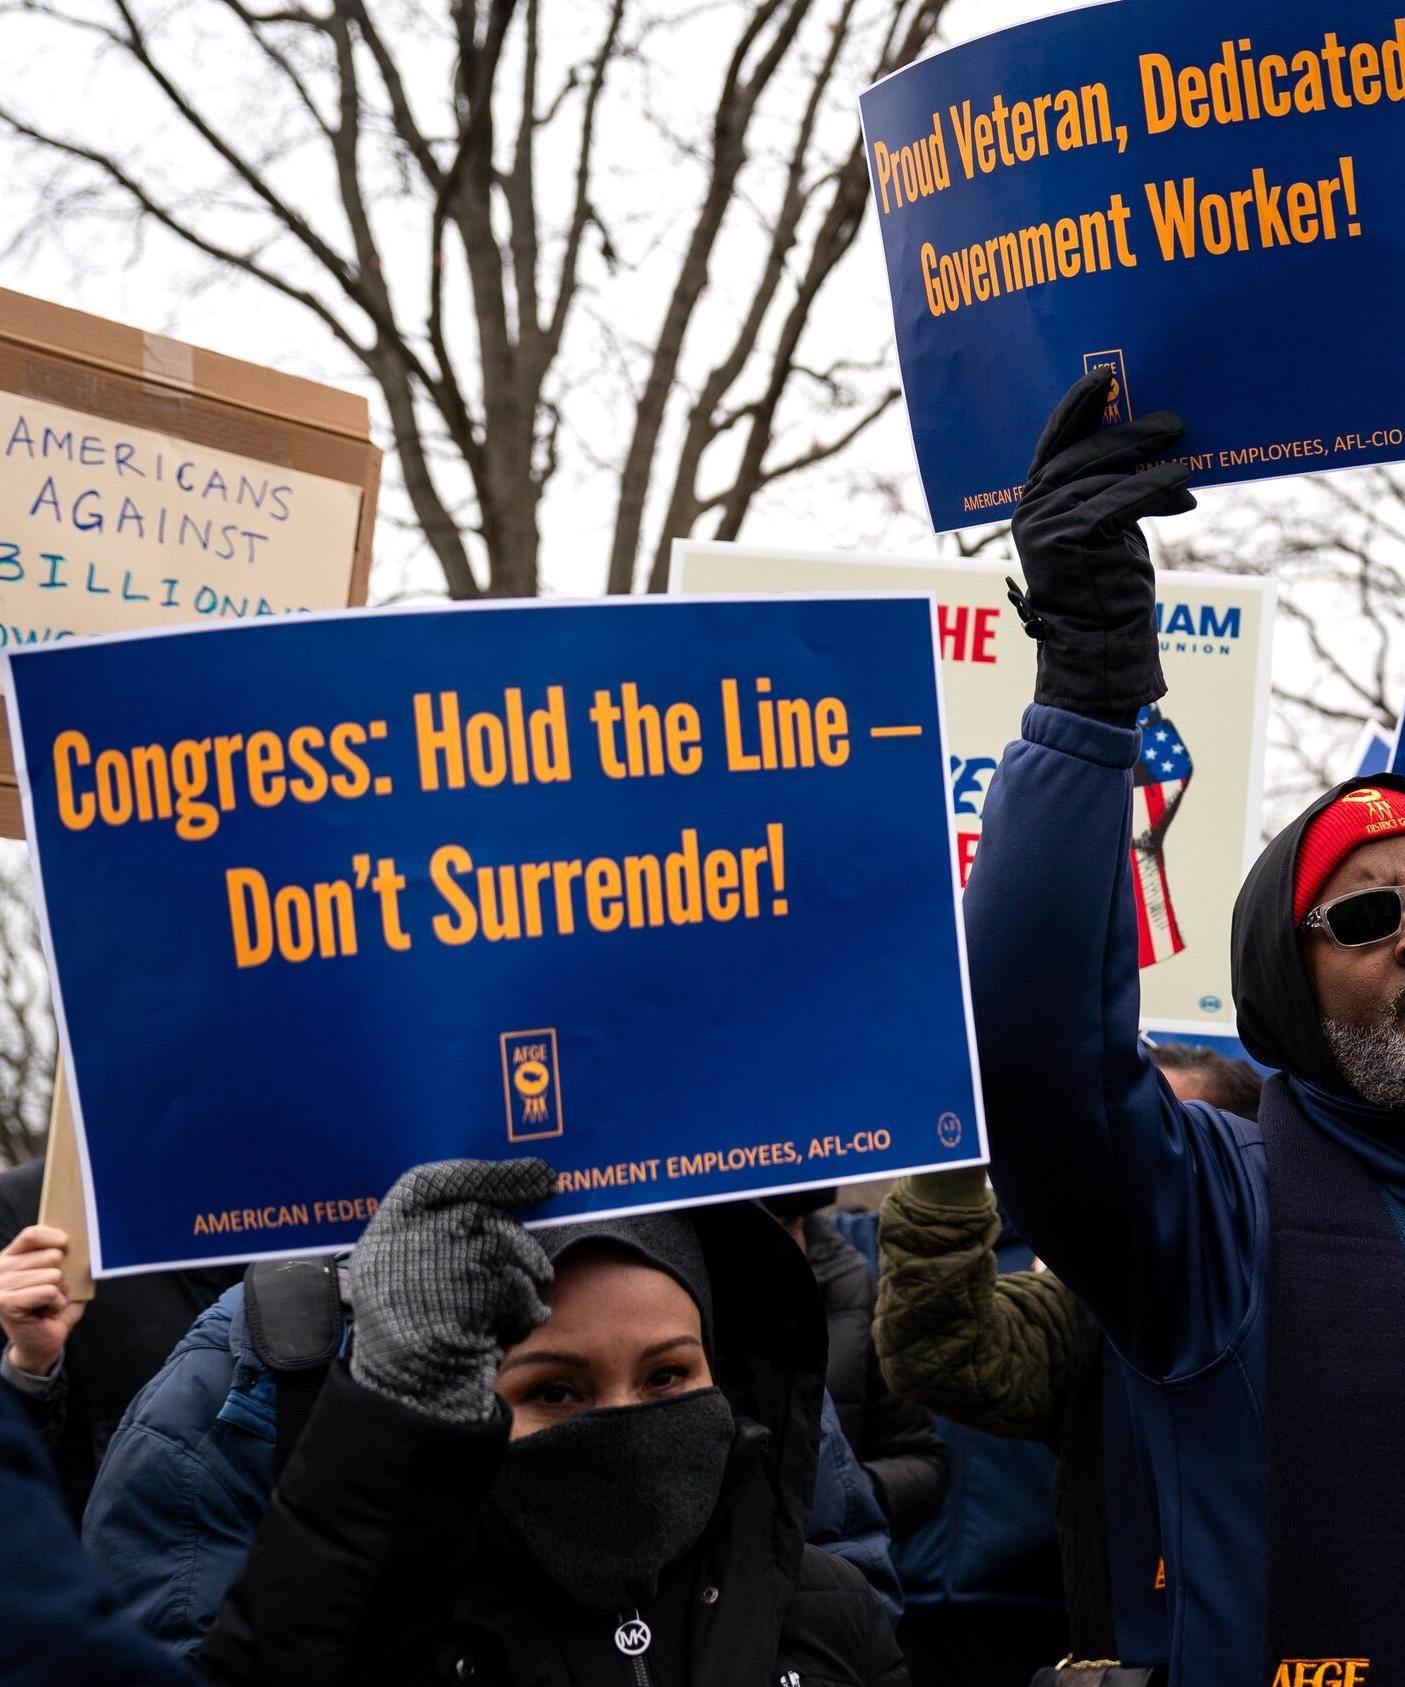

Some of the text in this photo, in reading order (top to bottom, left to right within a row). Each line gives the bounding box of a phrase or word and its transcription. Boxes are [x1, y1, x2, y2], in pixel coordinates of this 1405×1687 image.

[873, 113, 951, 214] Proud
[950, 82, 1128, 154] Veteran,
[921, 157, 1363, 317] Government Worker!
[5, 415, 294, 521] AMERICANS
[1219, 438, 1329, 468] EMPLOYEES,
[1334, 428, 1403, 452] AFL-CIO
[29, 476, 269, 563] AGAINST
[963, 485, 1026, 512] AMERICAN FE
[0, 542, 313, 618] BILLIONA
[1160, 641, 1231, 656] UNION
[54, 720, 392, 840] Congress:
[413, 685, 571, 791] Hold
[590, 682, 703, 778] the
[721, 677, 850, 772] Line
[226, 823, 788, 968] Don't Surrender!
[558, 1128, 892, 1194] RNMENT EMPLOYEES, AFL-CIO
[194, 1204, 309, 1235] AMERICAN
[619, 1626, 648, 1648] MK
